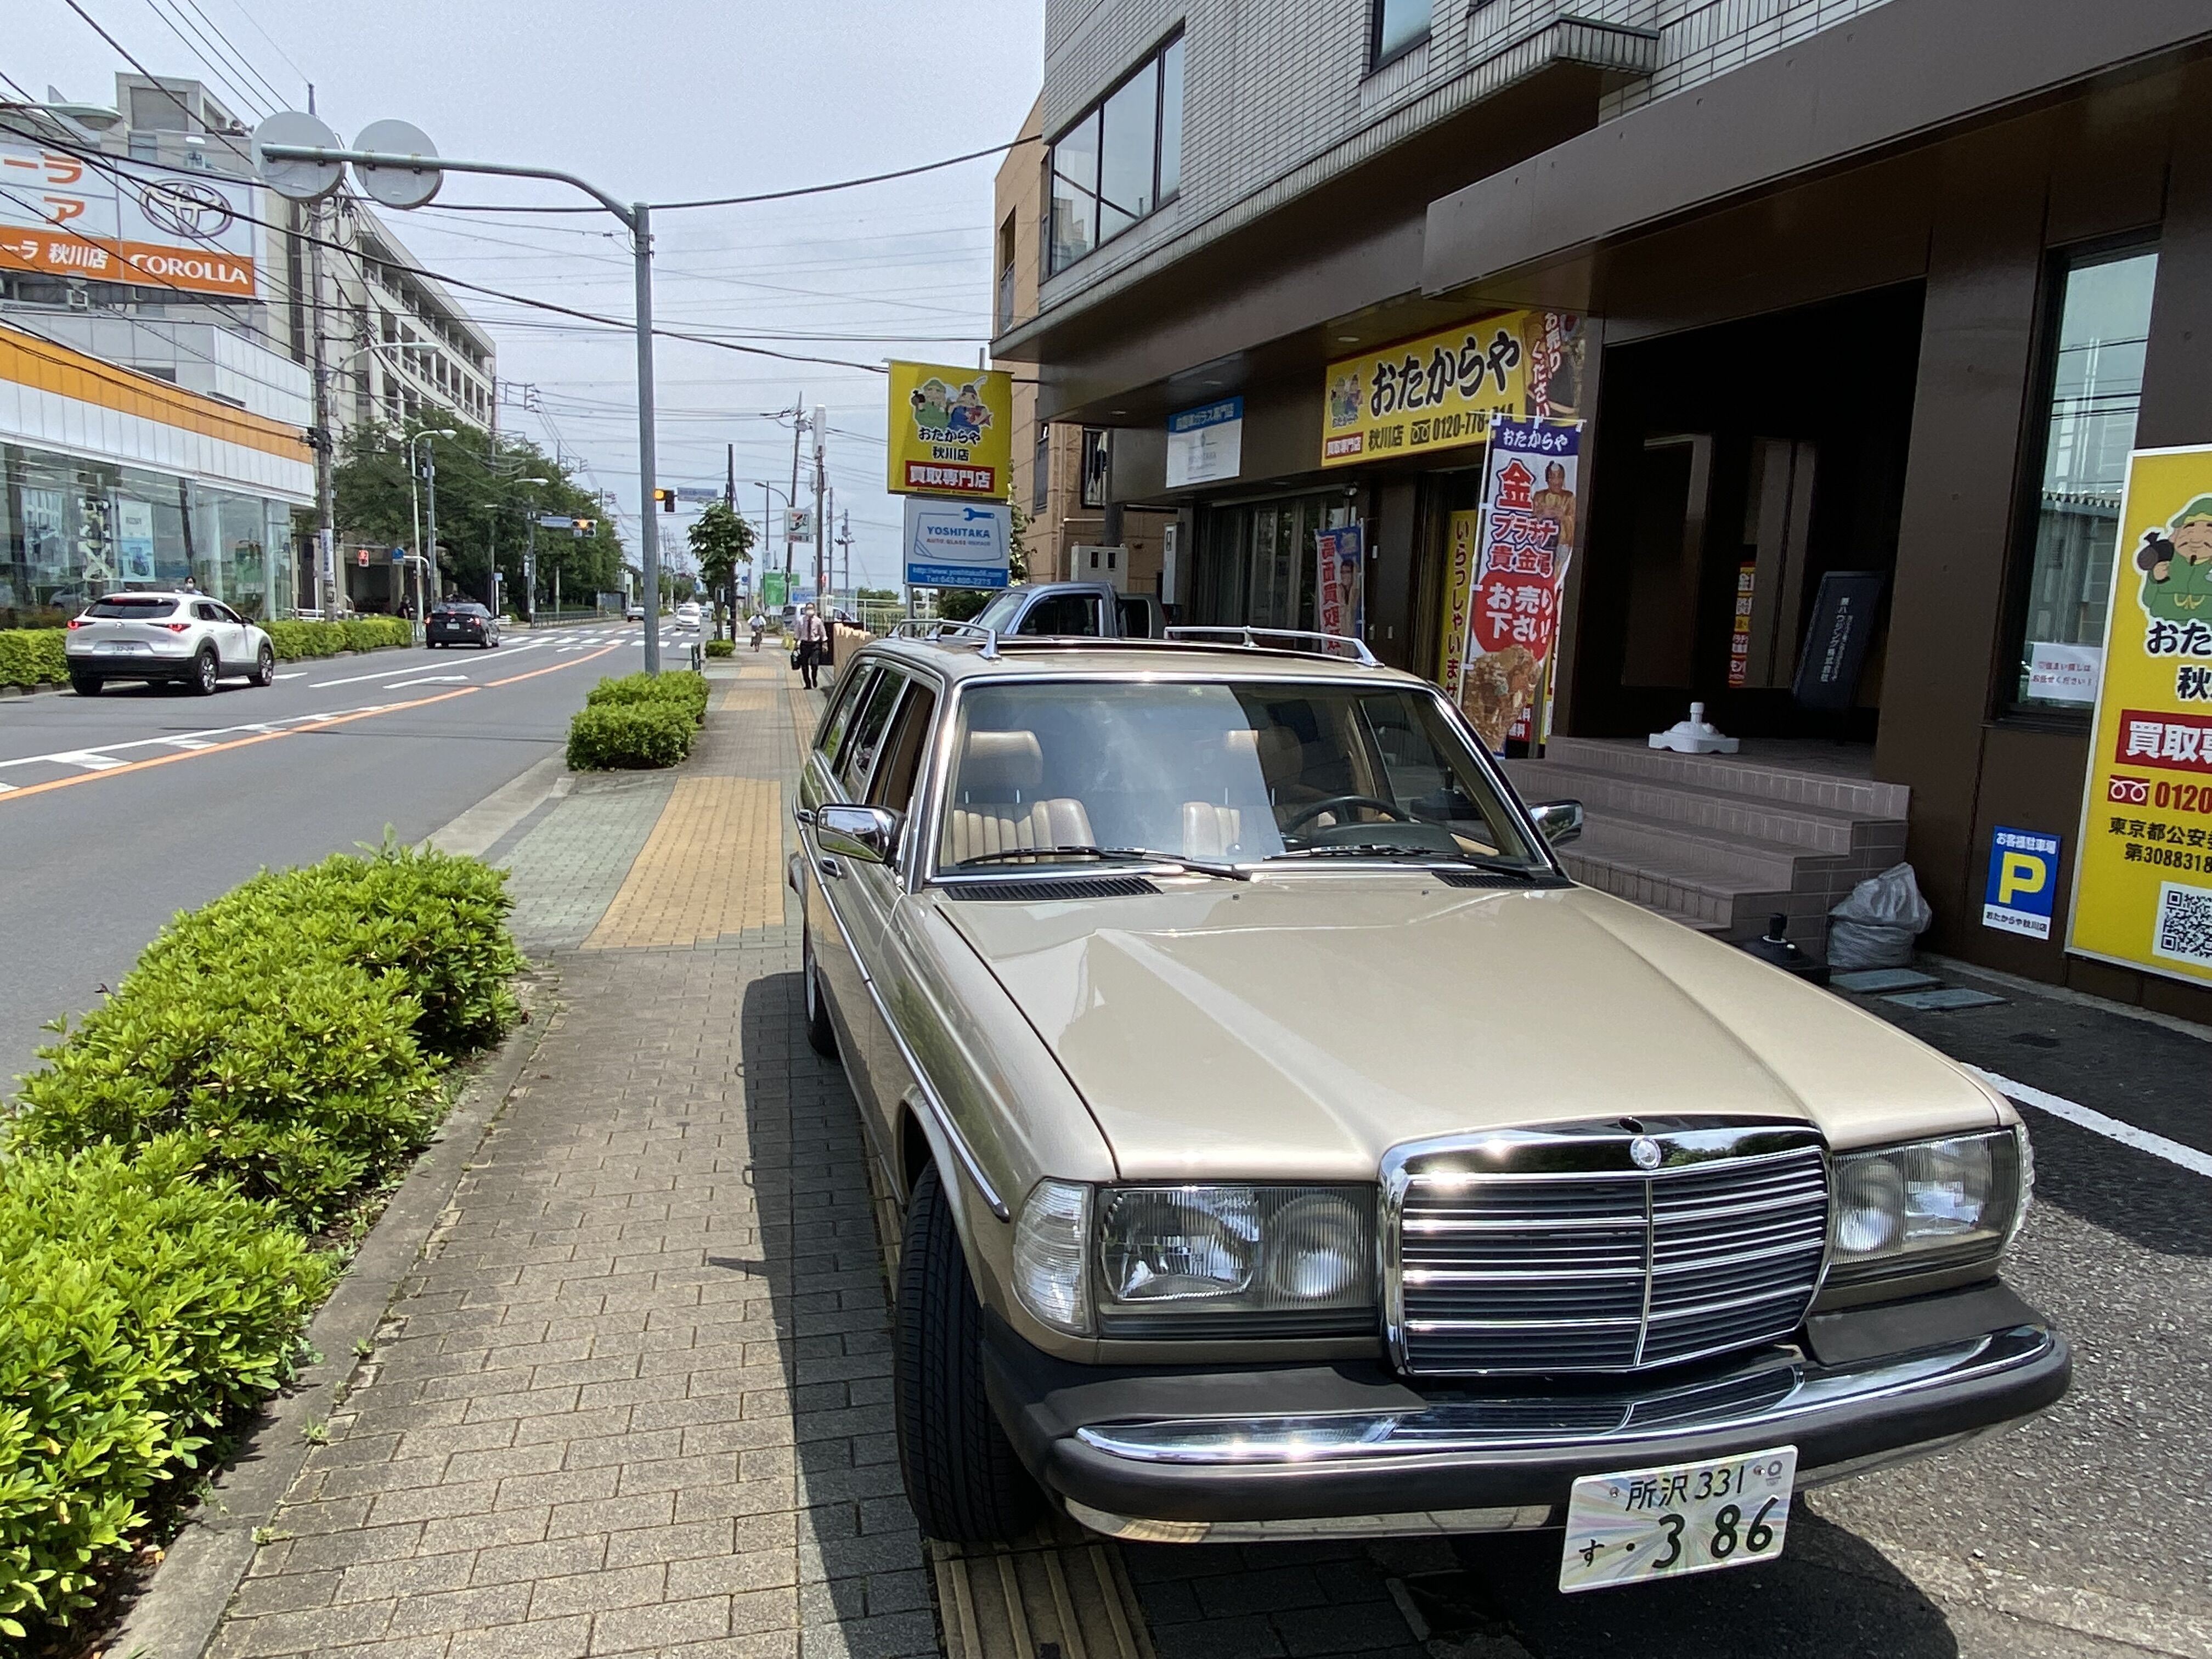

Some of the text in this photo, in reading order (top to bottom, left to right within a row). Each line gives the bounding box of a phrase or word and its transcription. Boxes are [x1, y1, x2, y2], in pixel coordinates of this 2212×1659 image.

[49, 242, 109, 269] 秋川店
[129, 253, 248, 285] COROLLA
[1372, 331, 1520, 417] おたからや
[918, 427, 981, 444] おたからや
[1368, 425, 1404, 452] 秋川店
[1503, 428, 1568, 452] おたからや
[933, 447, 969, 461] 秋川店
[909, 466, 991, 489] 買取専門店
[1498, 460, 1534, 510] 金
[927, 526, 991, 538] YOSHITAKA
[1492, 514, 1558, 548] プラチナ
[1489, 543, 1554, 578] 貴金属
[1446, 520, 1469, 698] いらっしゃいませ
[1487, 583, 1553, 616] お売り
[2177, 666, 2212, 699] 秋
[2154, 781, 2212, 814] 0120
[2108, 817, 2212, 850] 東京都公安
[1999, 851, 2046, 904] P
[1986, 911, 2047, 932] おたからや秋川店
